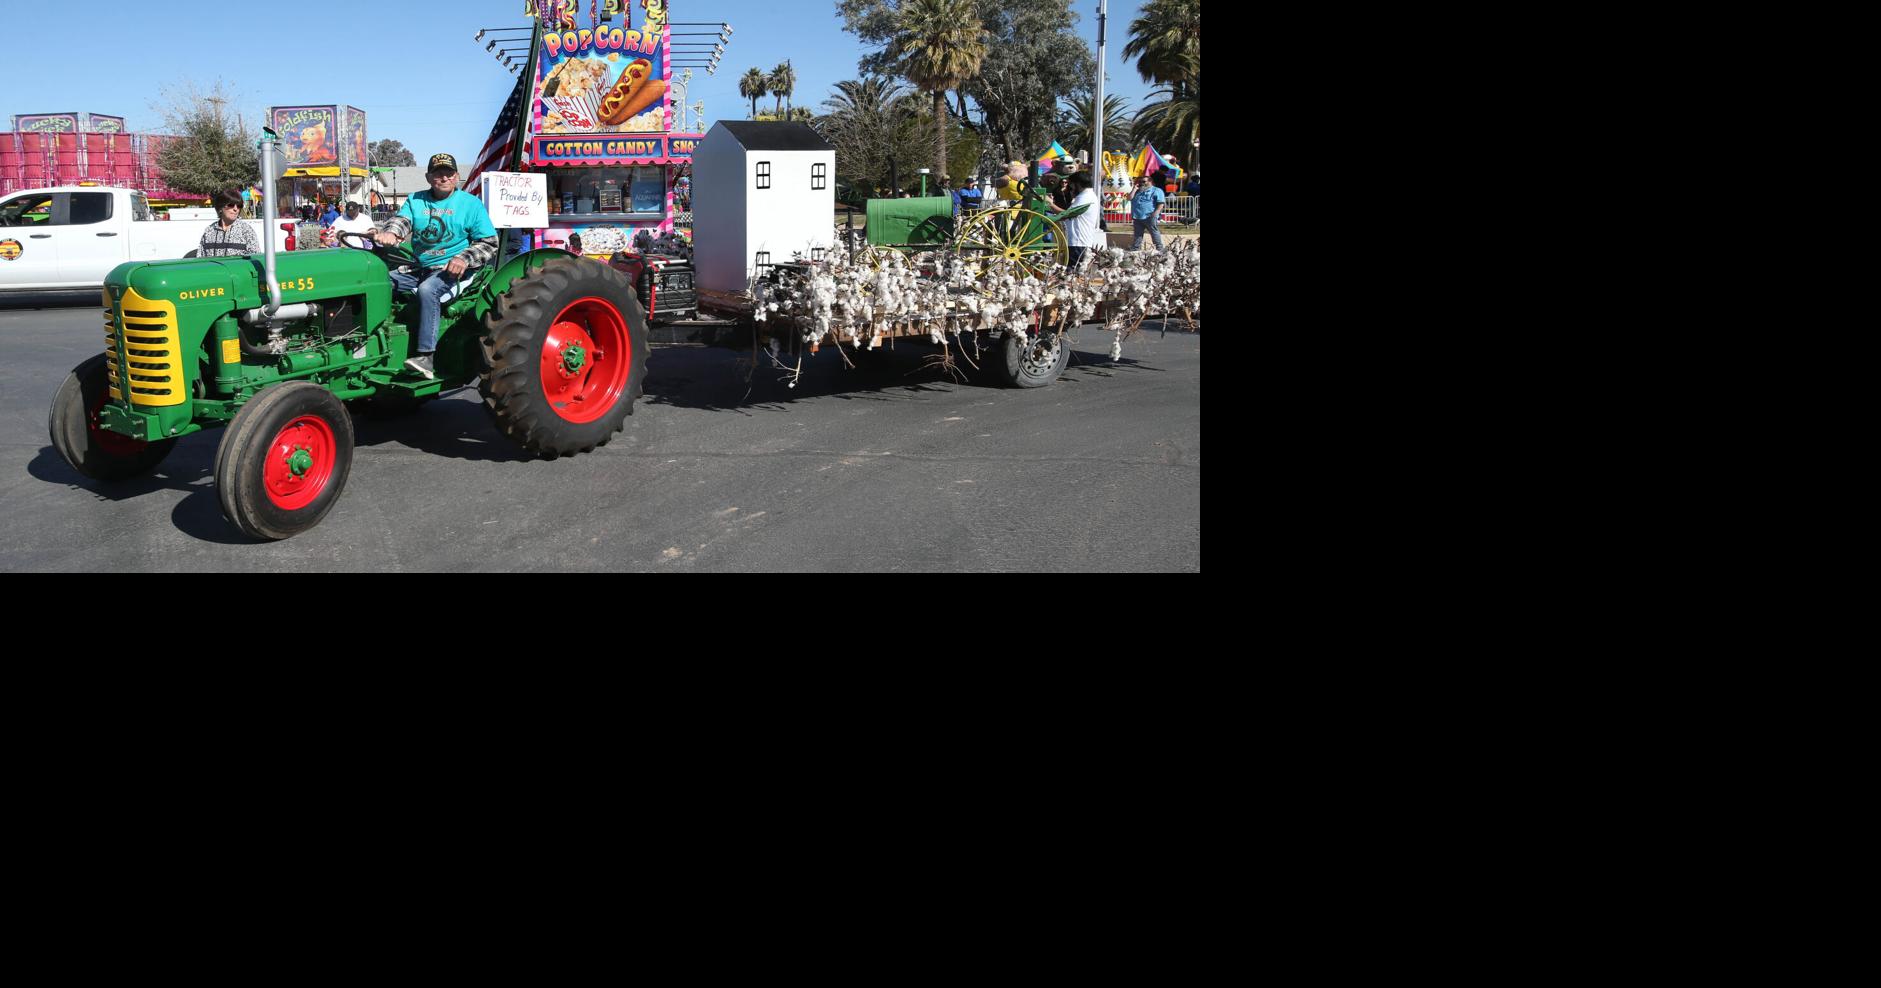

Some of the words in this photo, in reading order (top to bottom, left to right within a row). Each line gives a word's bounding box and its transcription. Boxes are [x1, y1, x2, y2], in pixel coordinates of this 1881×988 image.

[544, 25, 660, 57] POPCORN
[546, 140, 603, 156] COTTON
[606, 140, 656, 155] CANDY
[493, 175, 532, 188] TRACTOR
[500, 188, 528, 202] Provided
[531, 190, 543, 206] By
[503, 204, 530, 216] TAGS
[297, 277, 315, 291] 55
[179, 287, 225, 300] OLIVER
